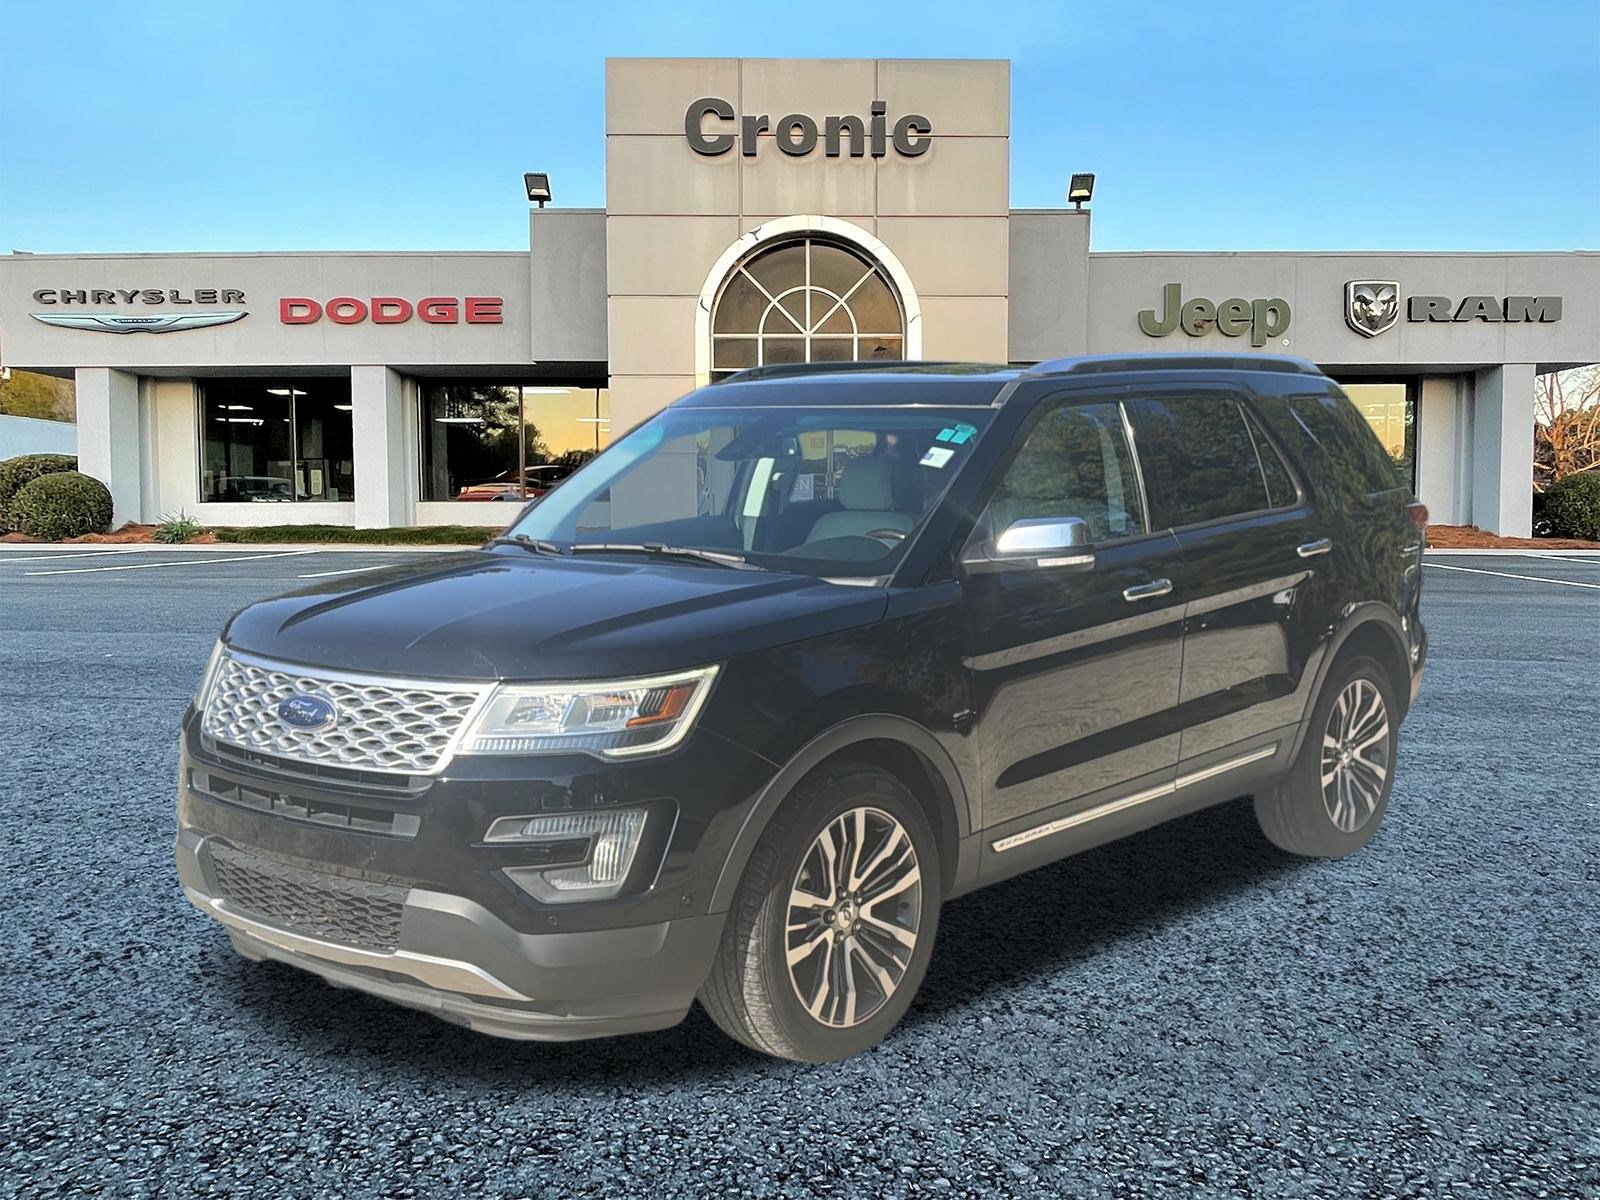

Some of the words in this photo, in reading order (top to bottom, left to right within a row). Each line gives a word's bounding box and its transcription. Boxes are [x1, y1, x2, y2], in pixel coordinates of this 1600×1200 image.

[685, 97, 932, 157] Cronic
[32, 289, 246, 305] CHRYSLER
[280, 297, 503, 324] DODGE
[1407, 296, 1563, 322] RAM
[1138, 283, 1291, 347] Jeep
